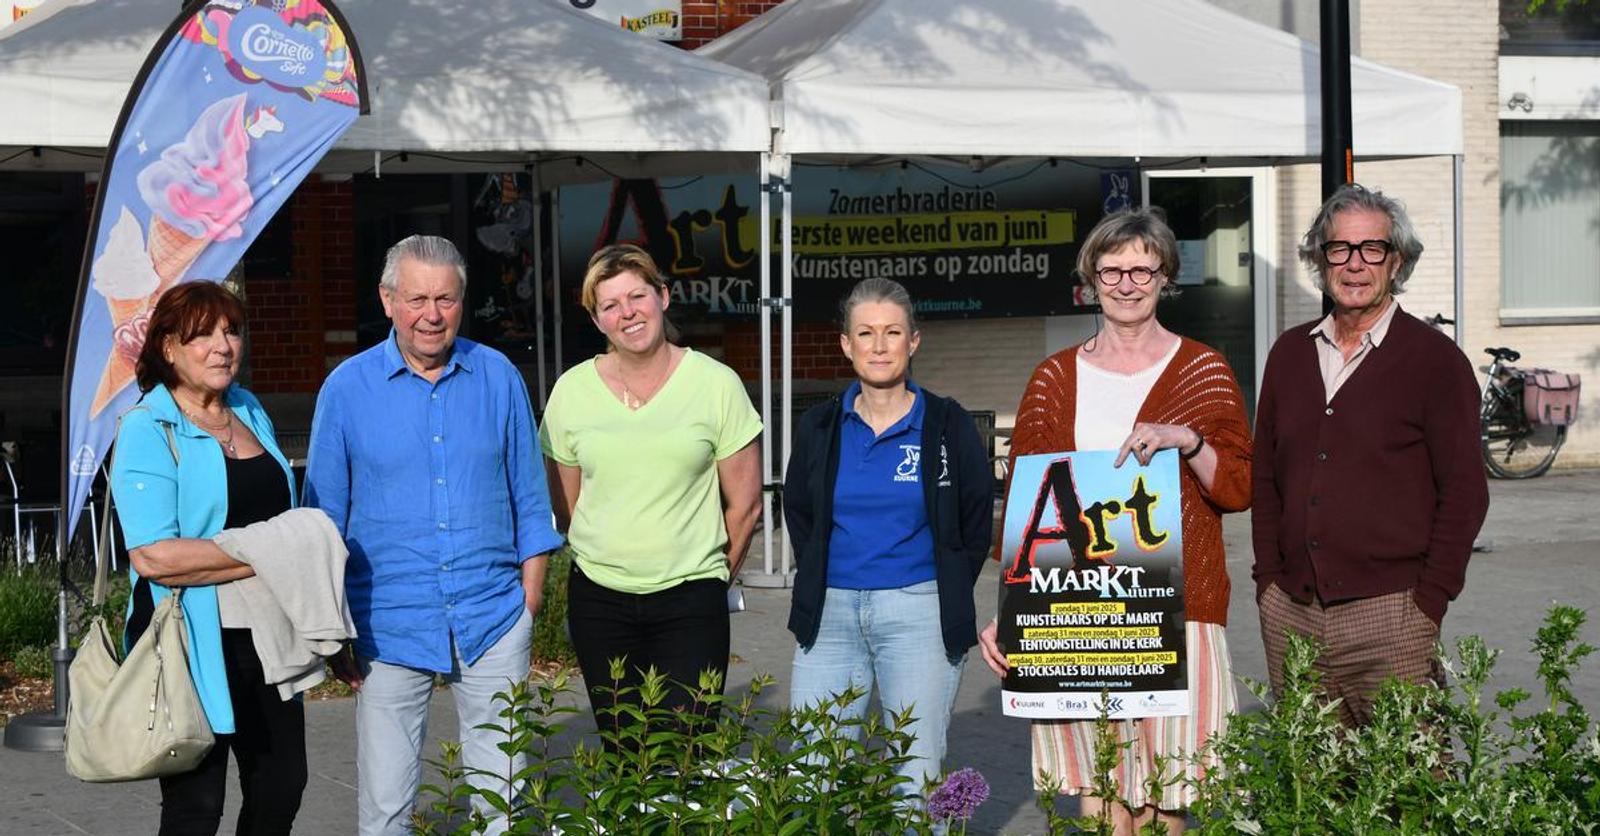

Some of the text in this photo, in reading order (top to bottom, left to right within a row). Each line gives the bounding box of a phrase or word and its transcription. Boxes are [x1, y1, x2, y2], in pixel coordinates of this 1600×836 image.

[627, 12, 673, 31] KASTEEL
[241, 24, 315, 62] Cornetto
[280, 61, 306, 75] Soft
[828, 185, 997, 214] Zomerbraderie
[588, 178, 754, 274] Art
[846, 216, 950, 245] weekend
[957, 221, 998, 241] van
[1004, 213, 1048, 245] juni
[934, 255, 962, 281] op
[967, 248, 1049, 279] zondag
[669, 276, 753, 313] ARKT
[1005, 457, 1169, 583] Art
[1029, 565, 1145, 598] MARKT
[1016, 612, 1164, 626] KUNSTENAARS OP DE MARKT
[1054, 605, 1081, 616] zondag
[1087, 604, 1100, 615] juni
[1101, 603, 1118, 612] 2025
[1020, 637, 1163, 650] TENTOONSTELLING IN DE KERK
[1028, 630, 1058, 639] zaterdag
[1060, 629, 1068, 637] 31
[1094, 629, 1118, 637] zondag
[1124, 629, 1138, 638] juni
[1045, 655, 1075, 665] zaterdag
[1110, 654, 1135, 664] zondag
[1142, 654, 1155, 664] juni
[1018, 664, 1165, 677] STOCKSALES BIJ HANDELAARS
[1066, 700, 1088, 709] Bra3
